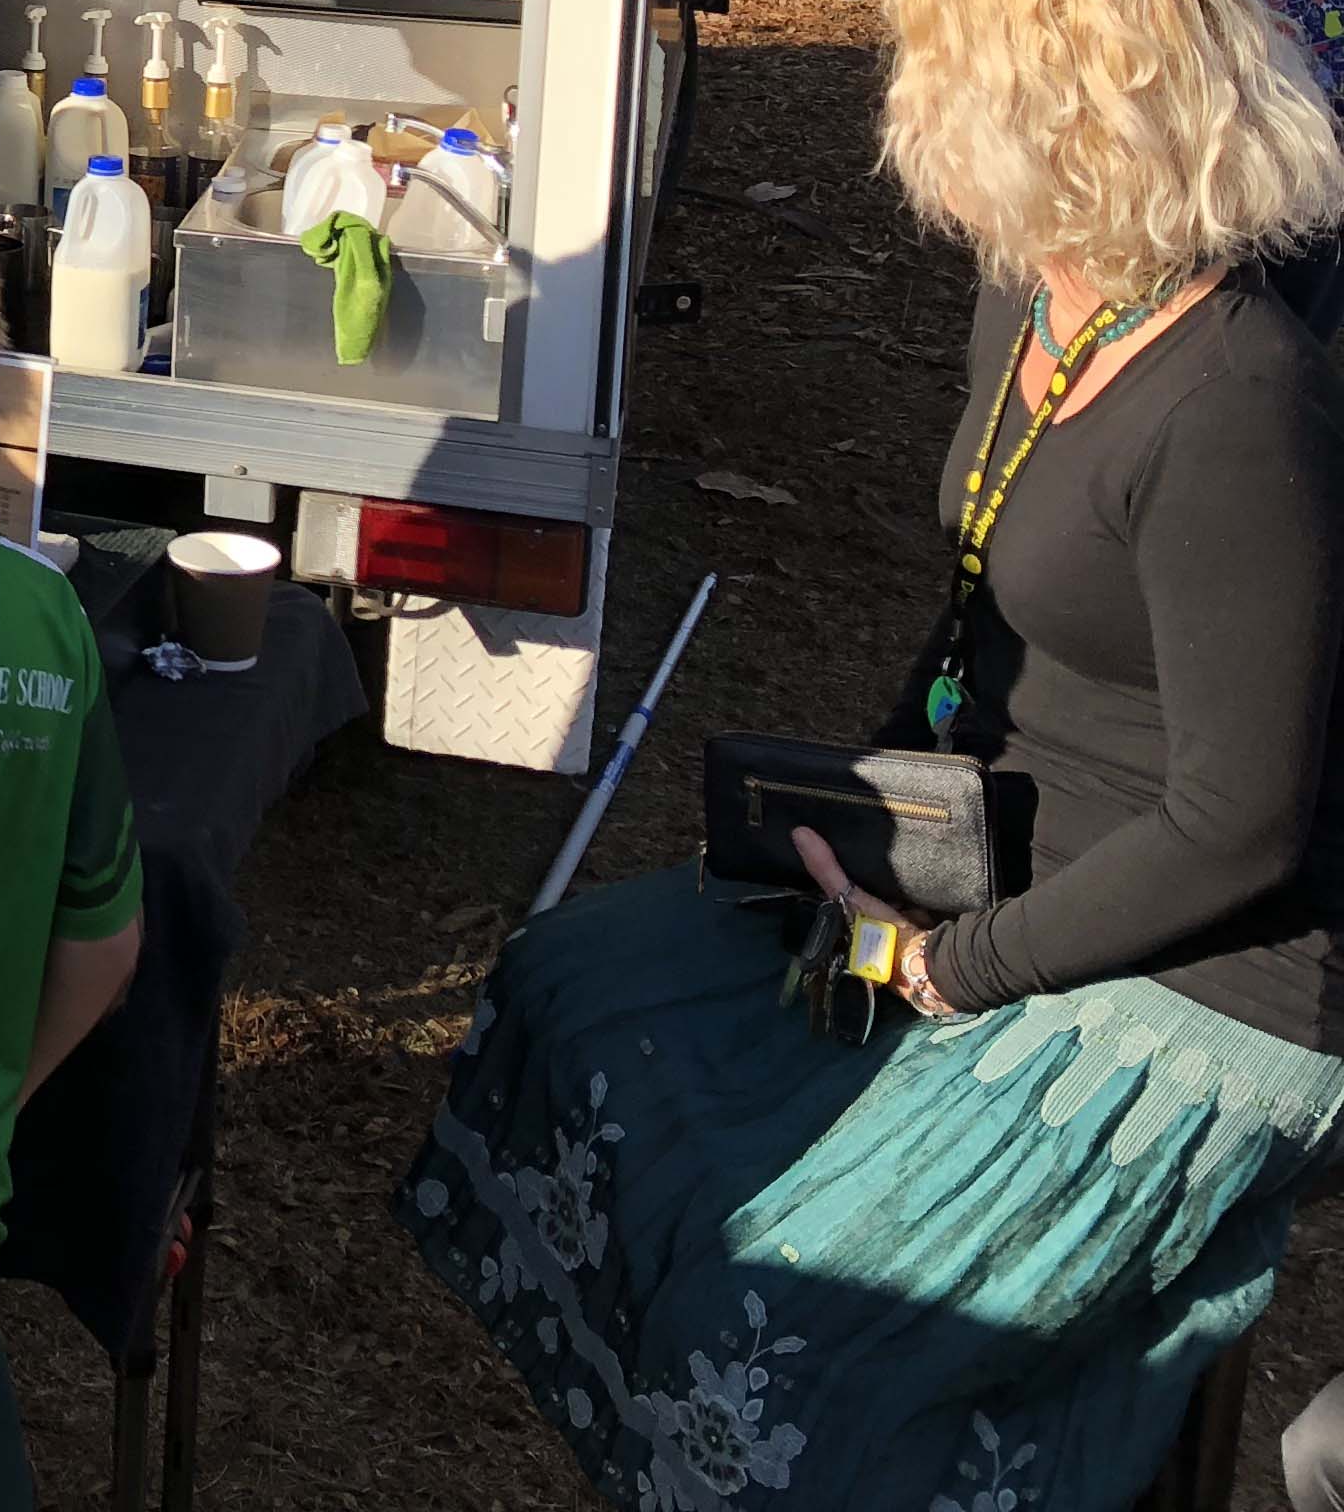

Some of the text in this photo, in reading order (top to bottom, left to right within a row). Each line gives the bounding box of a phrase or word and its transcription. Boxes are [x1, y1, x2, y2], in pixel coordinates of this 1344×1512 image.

[1062, 308, 1117, 368] Be Happy
[1002, 436, 1034, 480] Worry
[971, 507, 998, 550] Happy
[16, 668, 75, 714] SCHOOL
